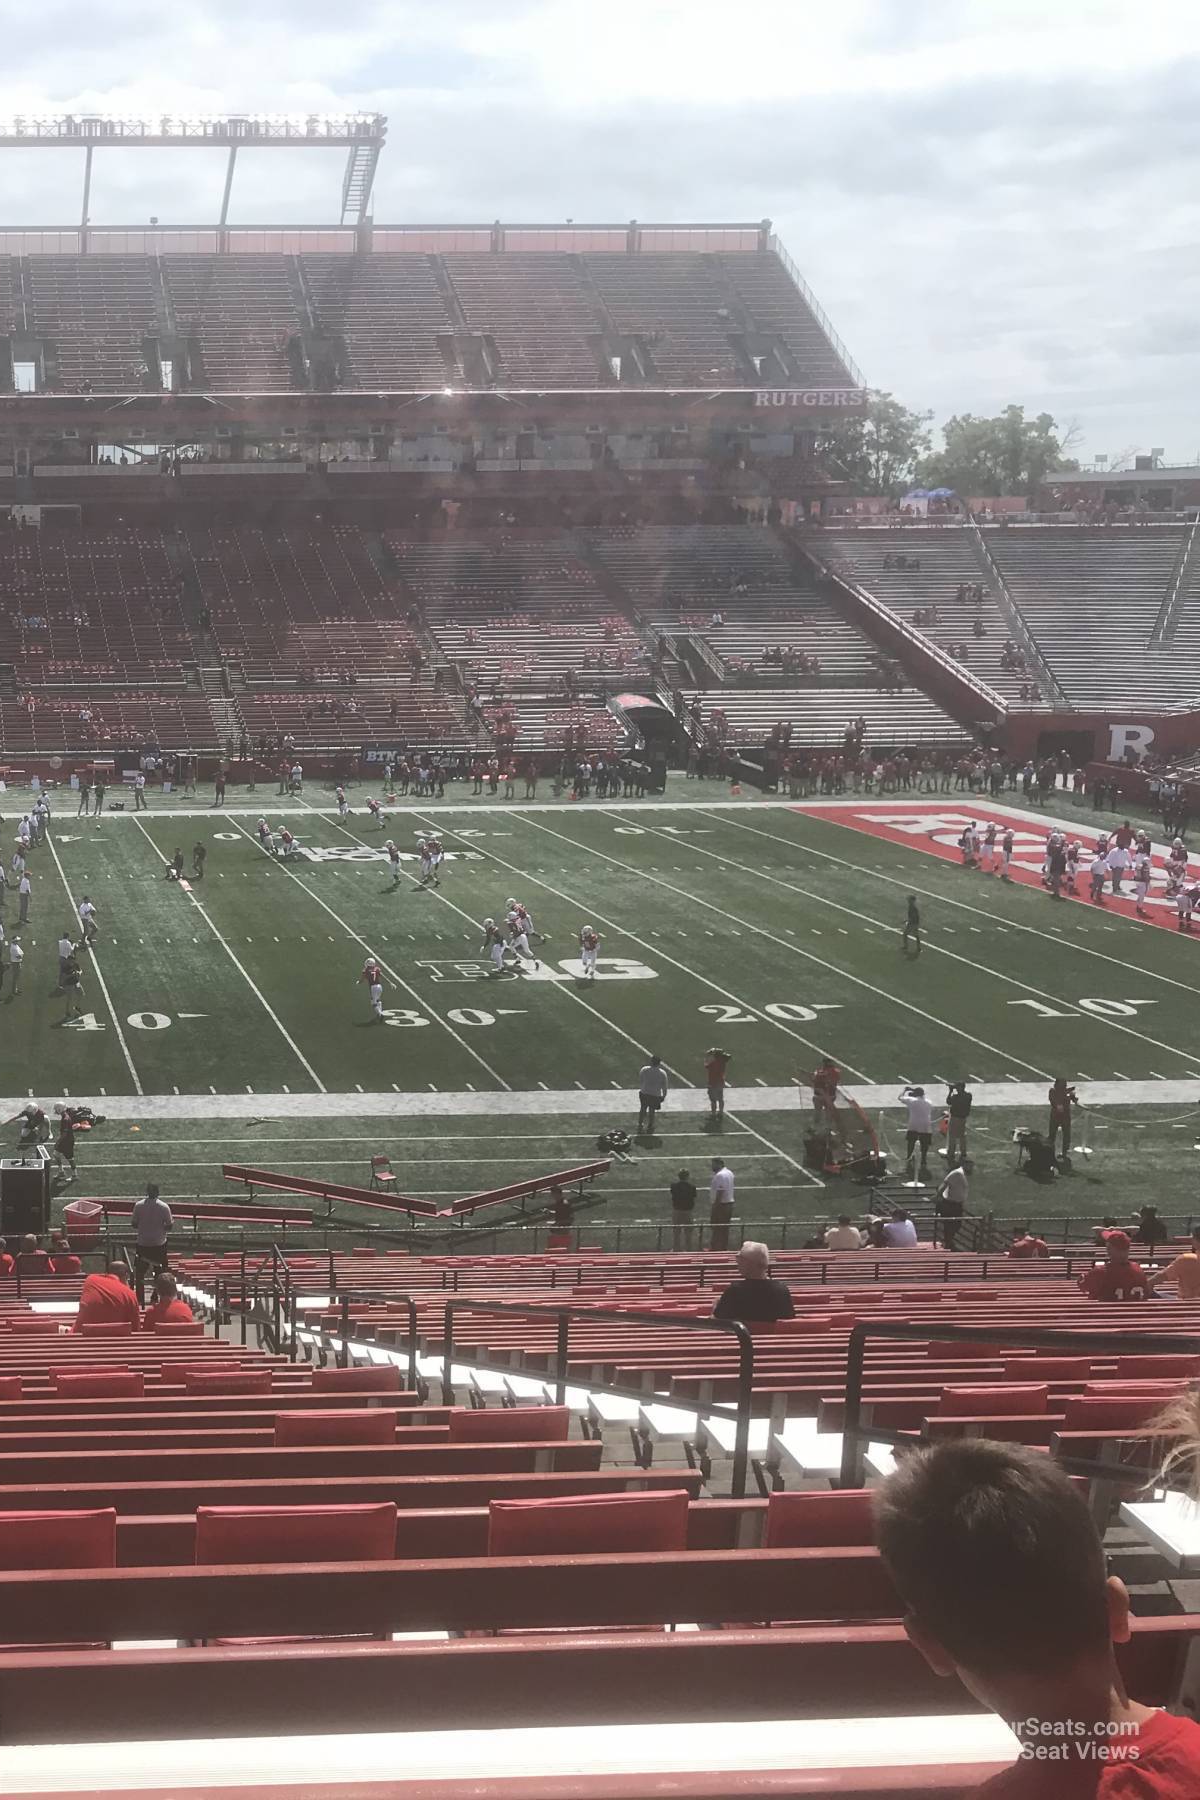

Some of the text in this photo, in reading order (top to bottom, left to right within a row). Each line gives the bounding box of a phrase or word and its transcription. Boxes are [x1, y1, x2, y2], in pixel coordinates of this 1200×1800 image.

[755, 391, 863, 406] RUTGERS
[1106, 724, 1155, 762] R
[366, 750, 398, 761] BTN
[61, 1012, 172, 1031] 40
[382, 1008, 496, 1027] 30
[698, 1003, 818, 1023] 20
